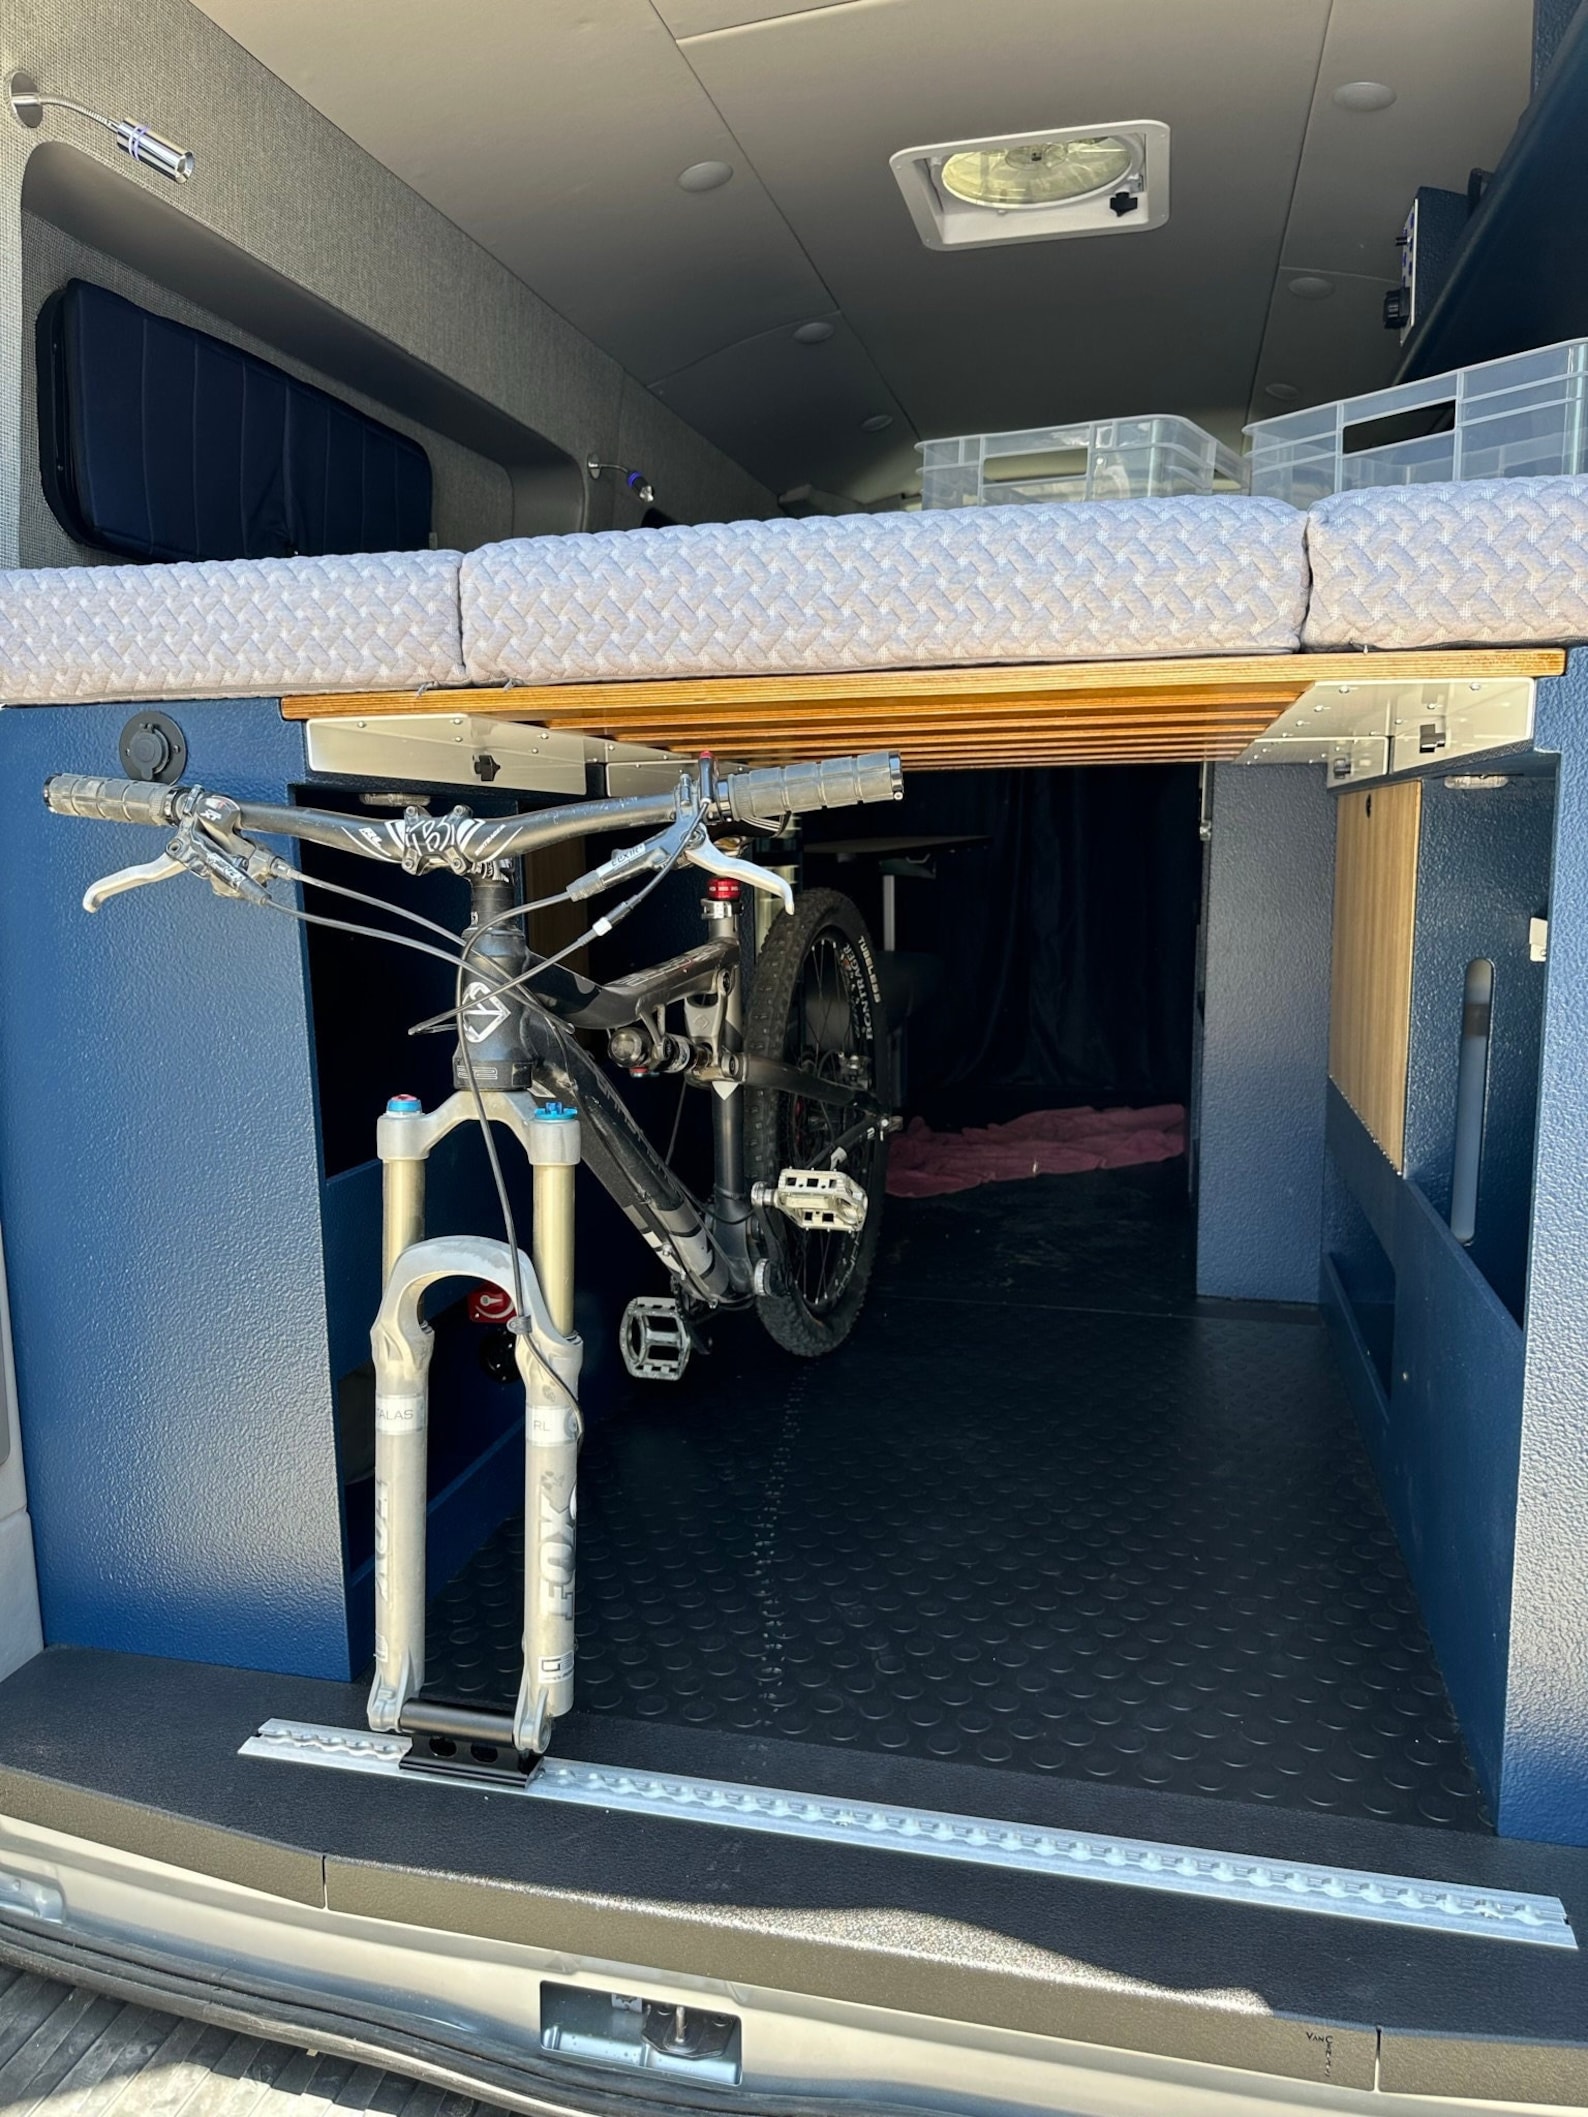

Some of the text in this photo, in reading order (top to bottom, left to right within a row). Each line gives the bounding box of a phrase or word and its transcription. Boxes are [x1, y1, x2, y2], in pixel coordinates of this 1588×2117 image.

[858, 935, 881, 1004] TUBELESS
[533, 1419, 550, 1432] RL
[539, 1490, 576, 1621] FOX
